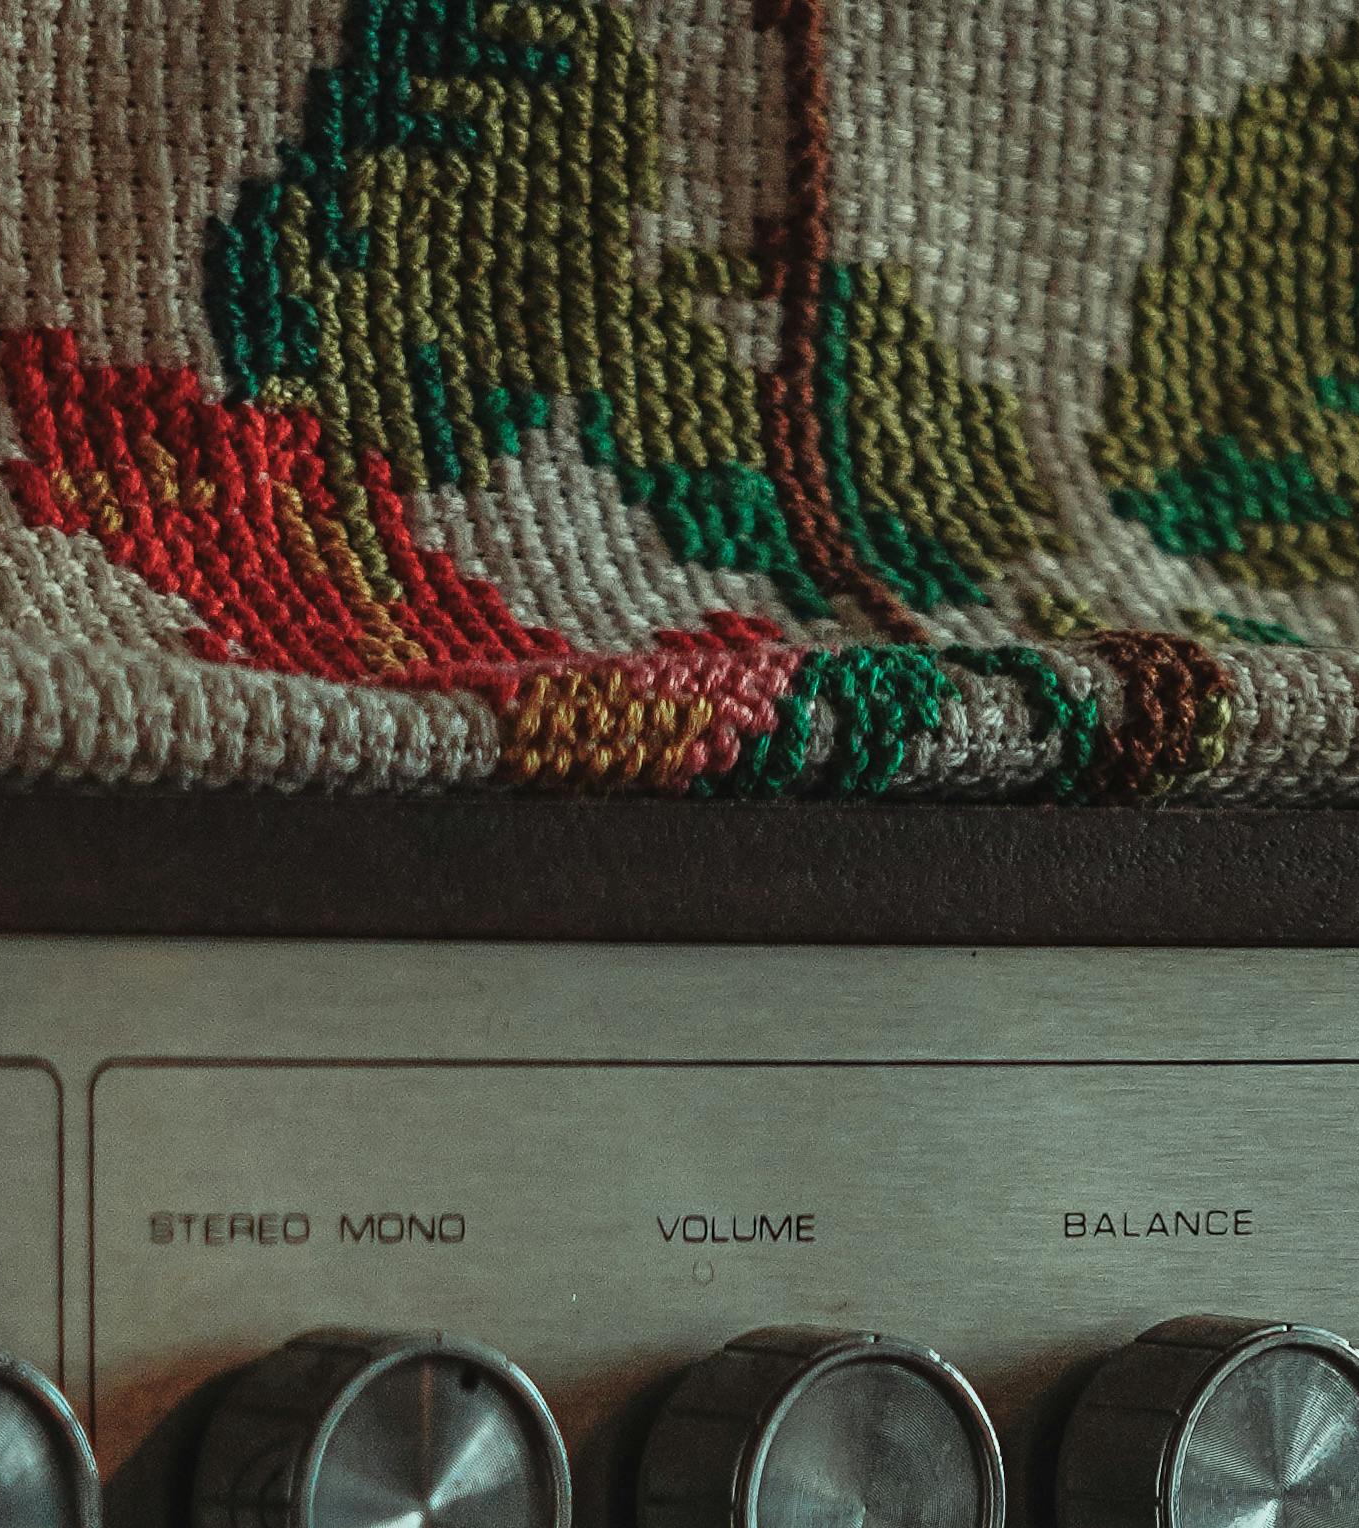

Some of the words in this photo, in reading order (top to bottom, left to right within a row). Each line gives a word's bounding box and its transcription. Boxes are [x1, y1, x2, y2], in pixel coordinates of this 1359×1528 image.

[150, 1214, 311, 1245] STEREO
[340, 1214, 466, 1243] MONO
[658, 1214, 814, 1243] VOLUME
[1064, 1210, 1253, 1238] BALANCE
